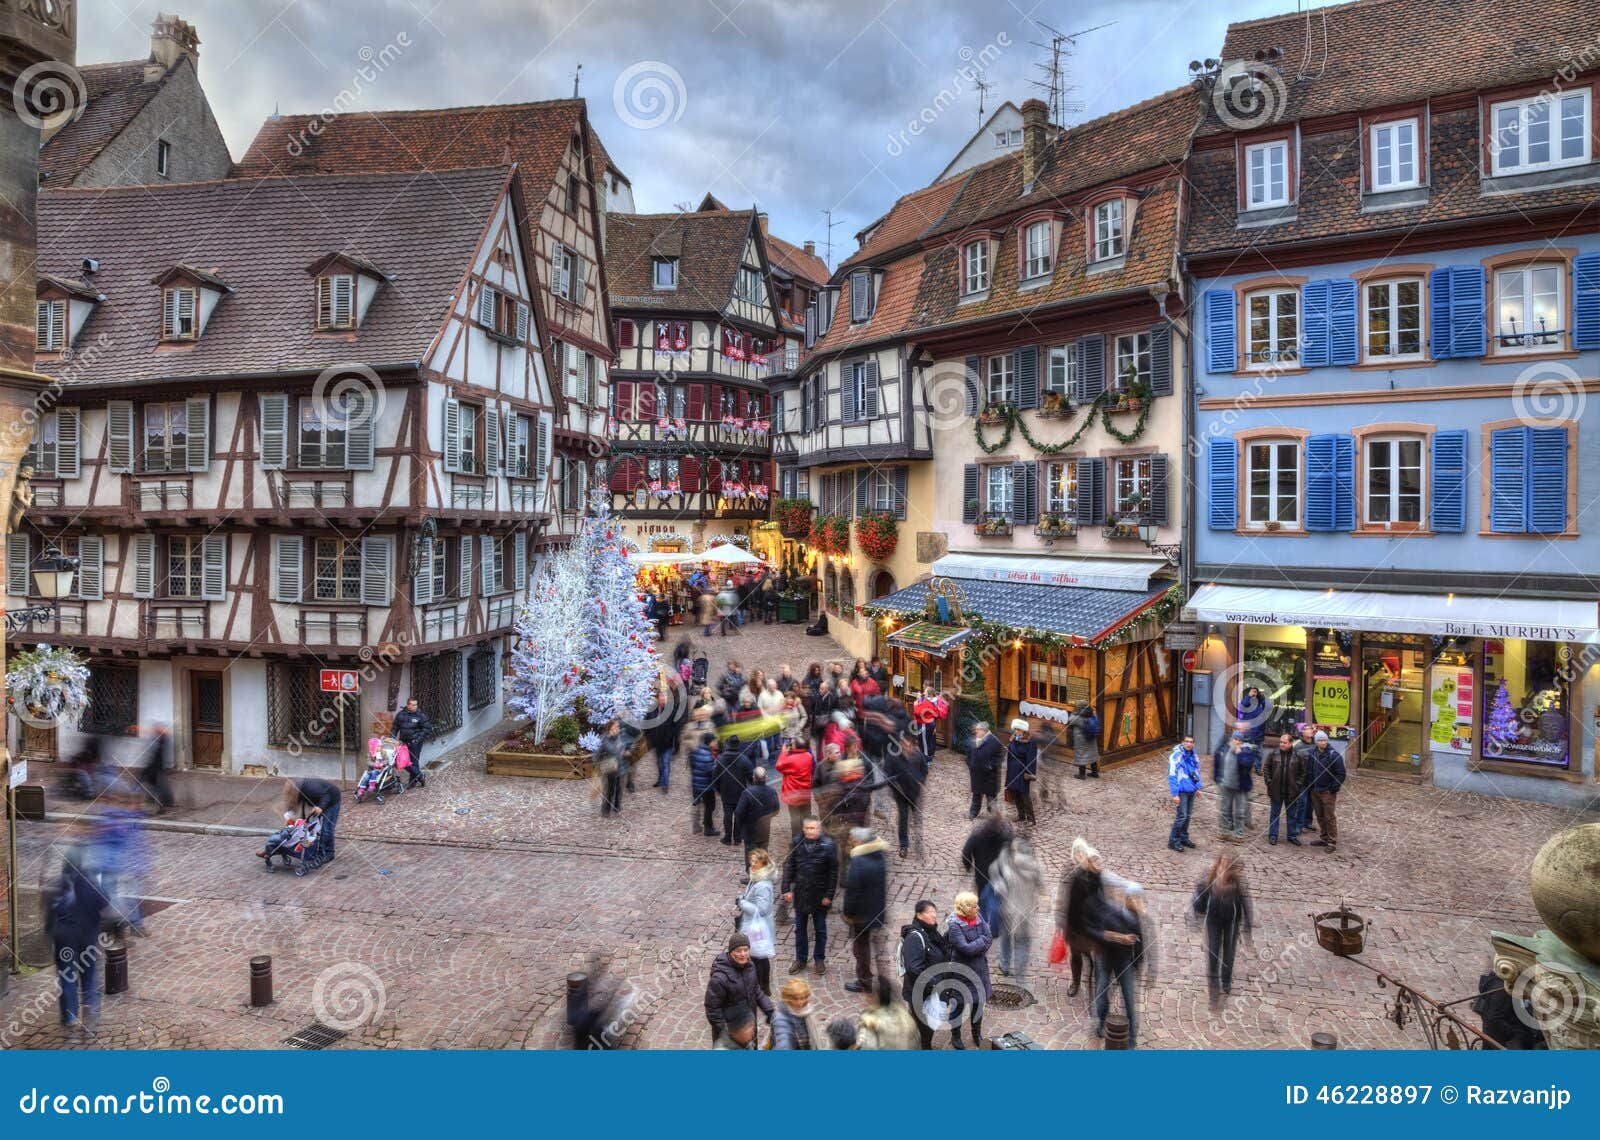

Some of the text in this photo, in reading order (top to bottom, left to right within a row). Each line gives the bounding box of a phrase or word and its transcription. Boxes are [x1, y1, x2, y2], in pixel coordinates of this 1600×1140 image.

[637, 522, 675, 536] pignon
[1225, 612, 1279, 624] wazawok
[1445, 622, 1576, 641] Bar le MURPHY'S
[1315, 686, 1348, 700] -10%
